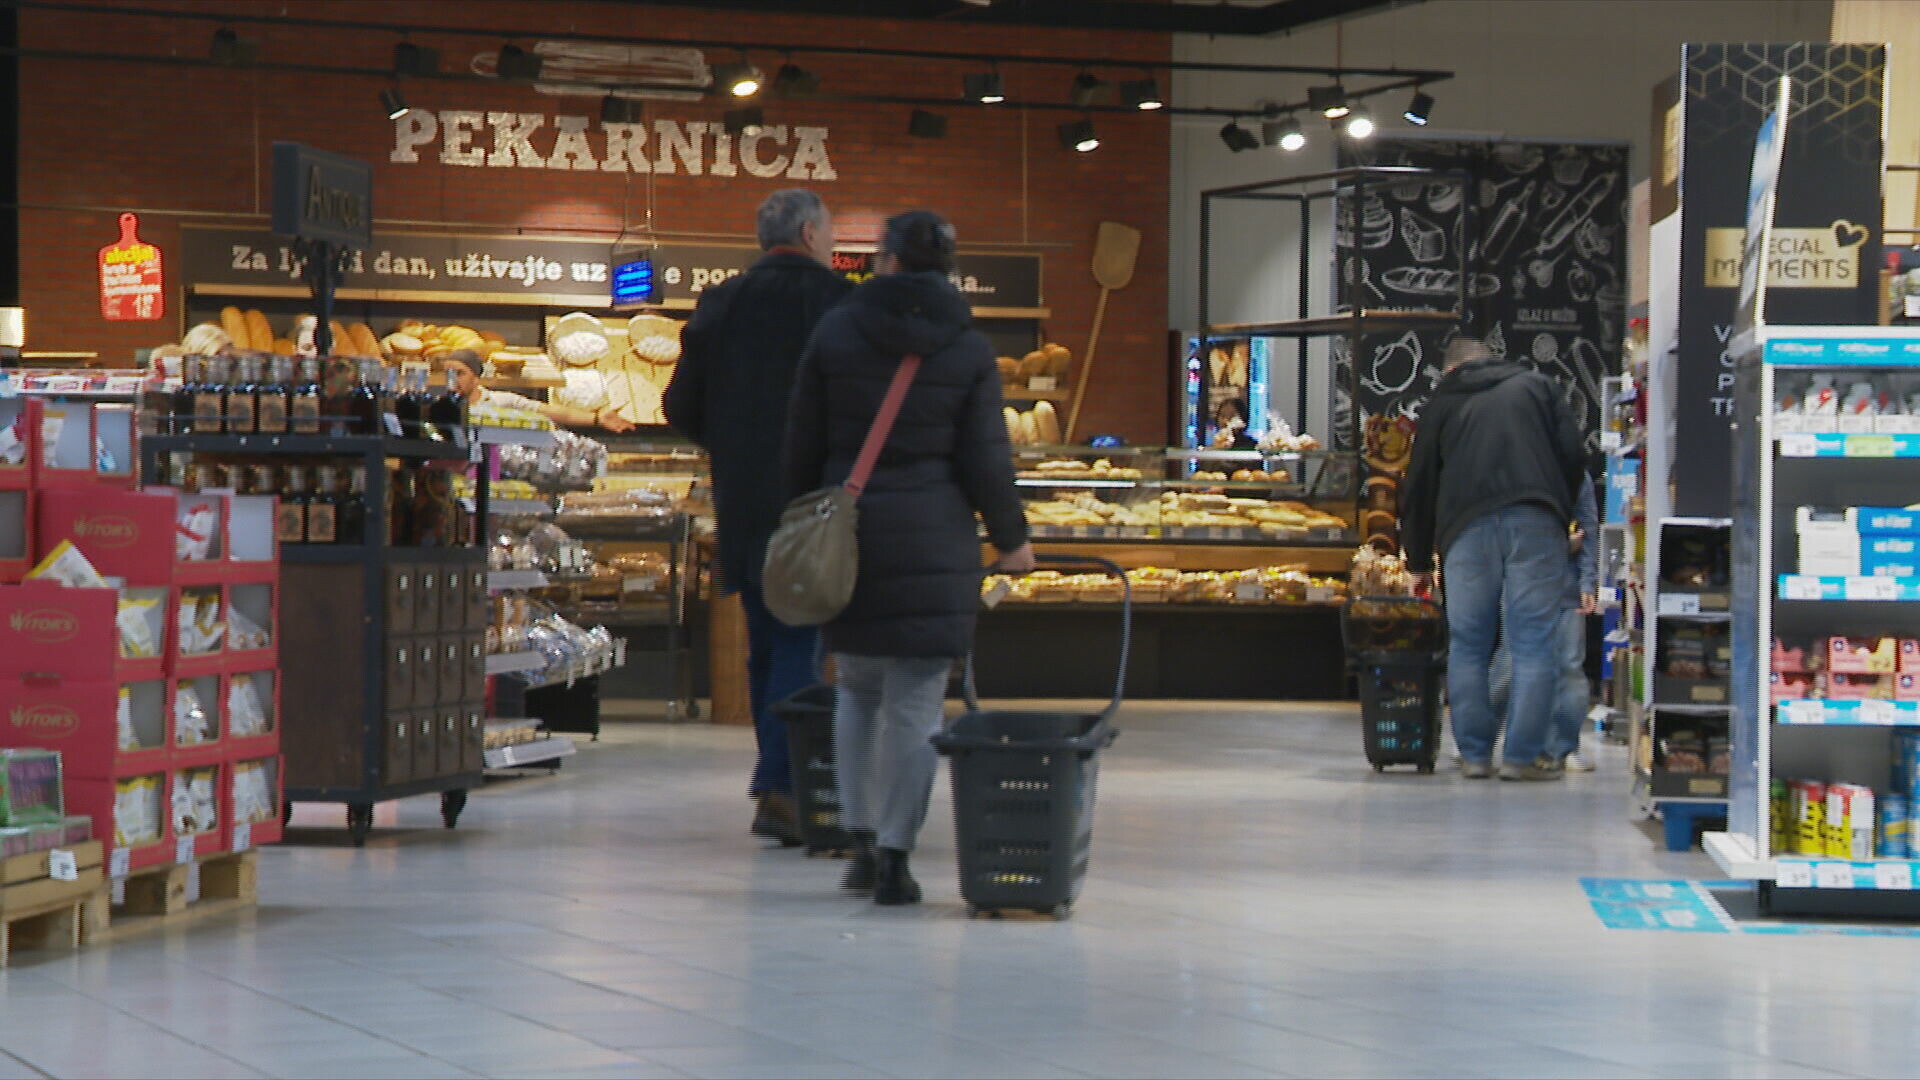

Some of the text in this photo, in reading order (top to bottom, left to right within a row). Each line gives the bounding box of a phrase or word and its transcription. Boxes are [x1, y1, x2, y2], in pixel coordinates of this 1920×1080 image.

[389, 108, 838, 181] PEKARNICA
[231, 245, 268, 271] Za
[373, 250, 436, 280] dan,
[445, 252, 563, 287] uživajte
[571, 261, 608, 282] uz
